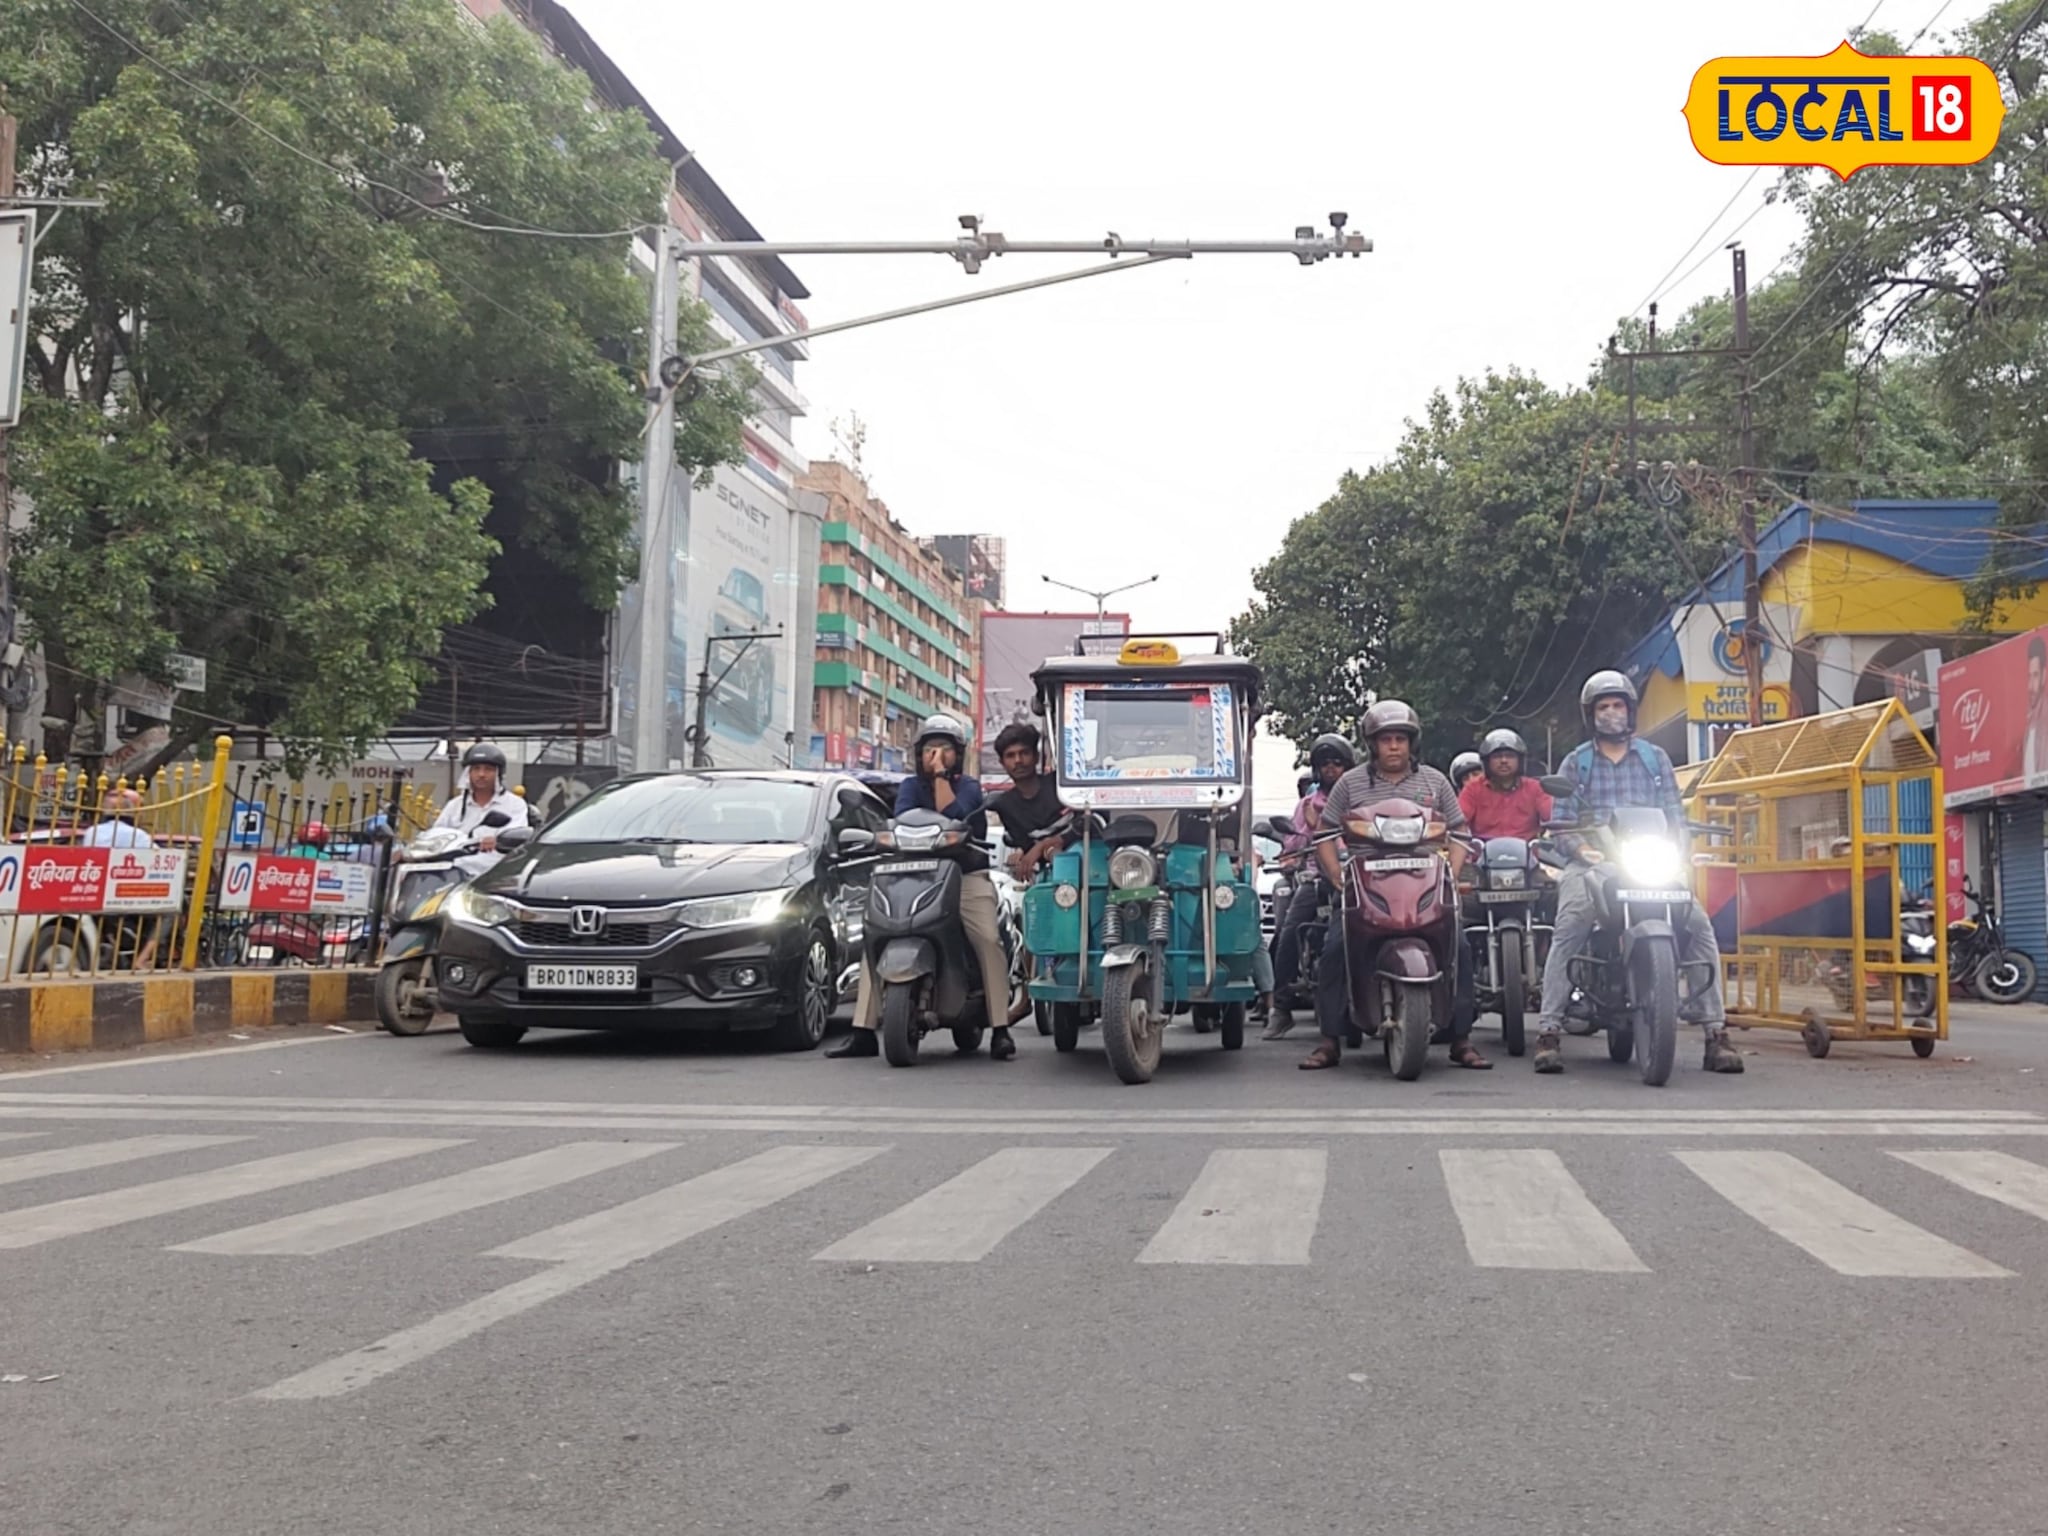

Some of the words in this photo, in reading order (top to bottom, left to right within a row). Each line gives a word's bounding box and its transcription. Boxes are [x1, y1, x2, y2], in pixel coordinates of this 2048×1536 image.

[1960, 692, 1984, 724] itel
[28, 859, 78, 890] यूनियन
[79, 859, 103, 882] बैंक
[257, 865, 294, 891] यूनियन
[537, 969, 635, 985] BR01DN8833
